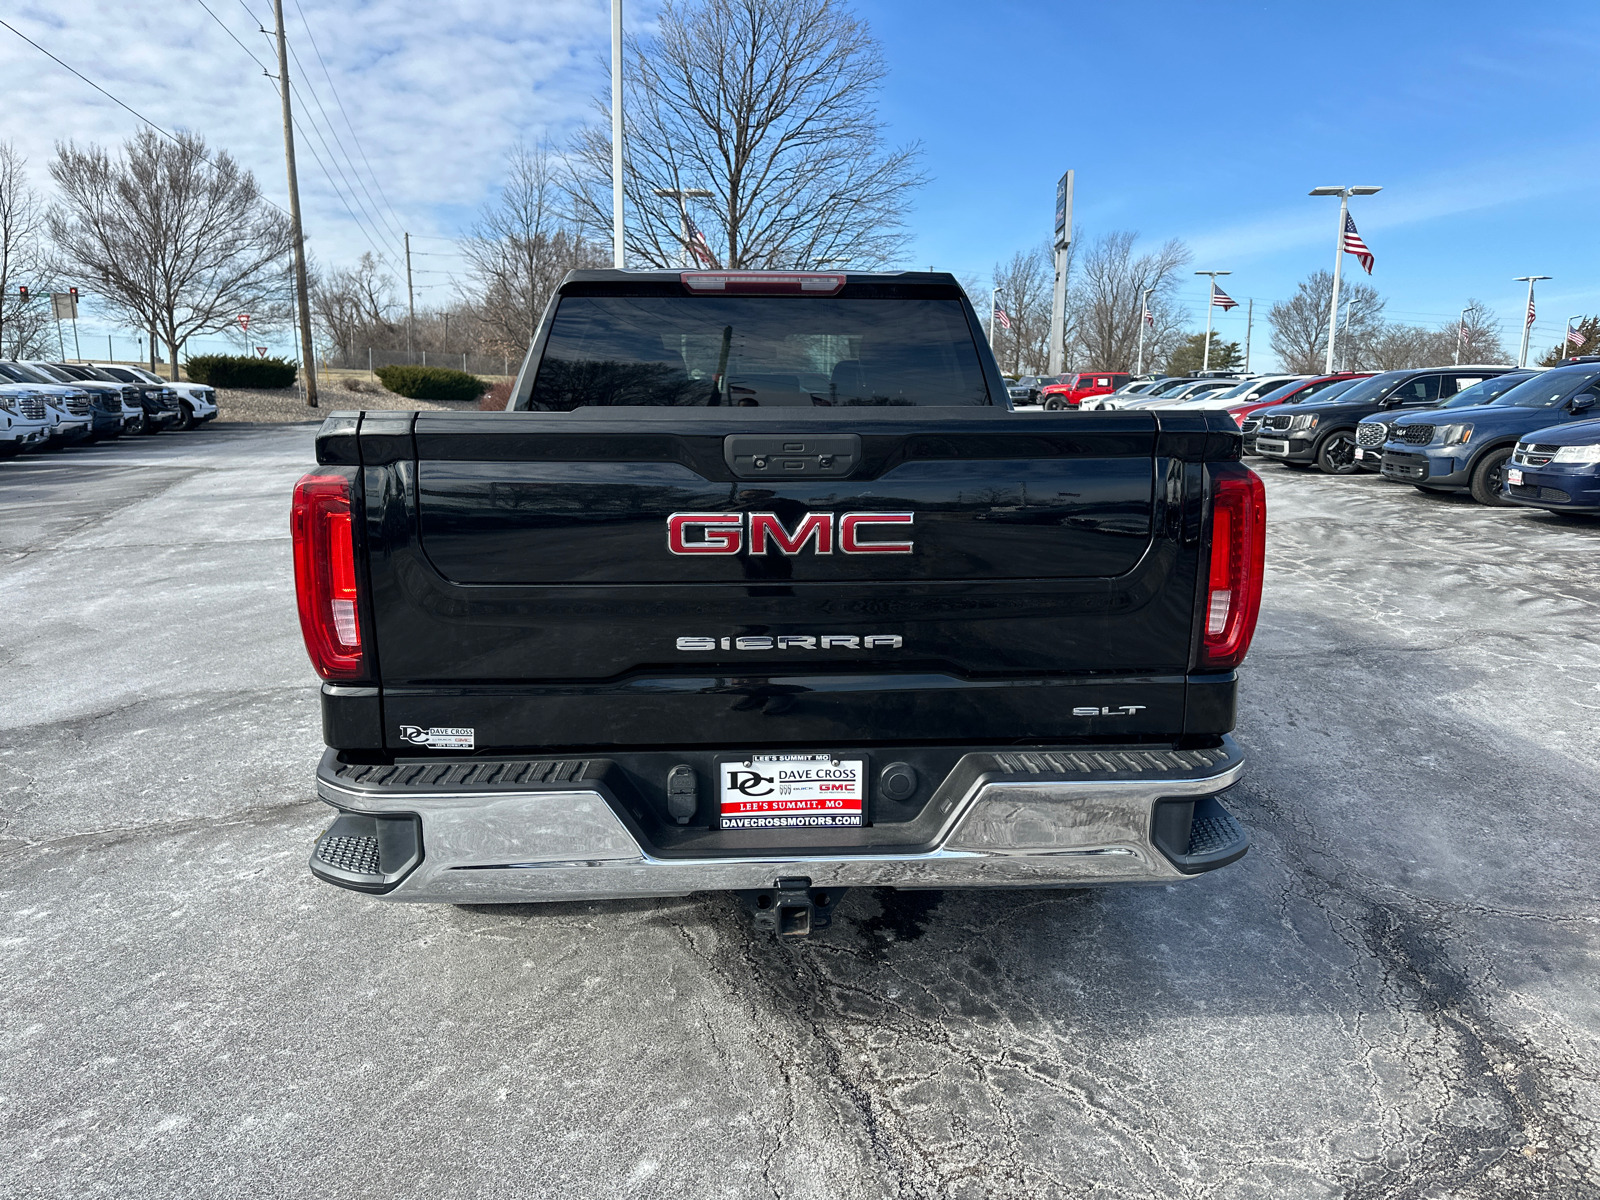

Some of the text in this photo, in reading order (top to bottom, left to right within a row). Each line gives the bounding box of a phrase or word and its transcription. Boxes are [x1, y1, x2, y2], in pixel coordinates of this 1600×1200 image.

[666, 511, 914, 556] GMC
[676, 635, 903, 650] SIERRA
[1072, 705, 1147, 716] SLT
[778, 769, 856, 779] DAVE CROSS
[819, 783, 856, 791] GMC
[740, 800, 843, 811] LEE'S SUMMIT, MO
[722, 816, 860, 828] DAVECROSSMOTORS.COM
